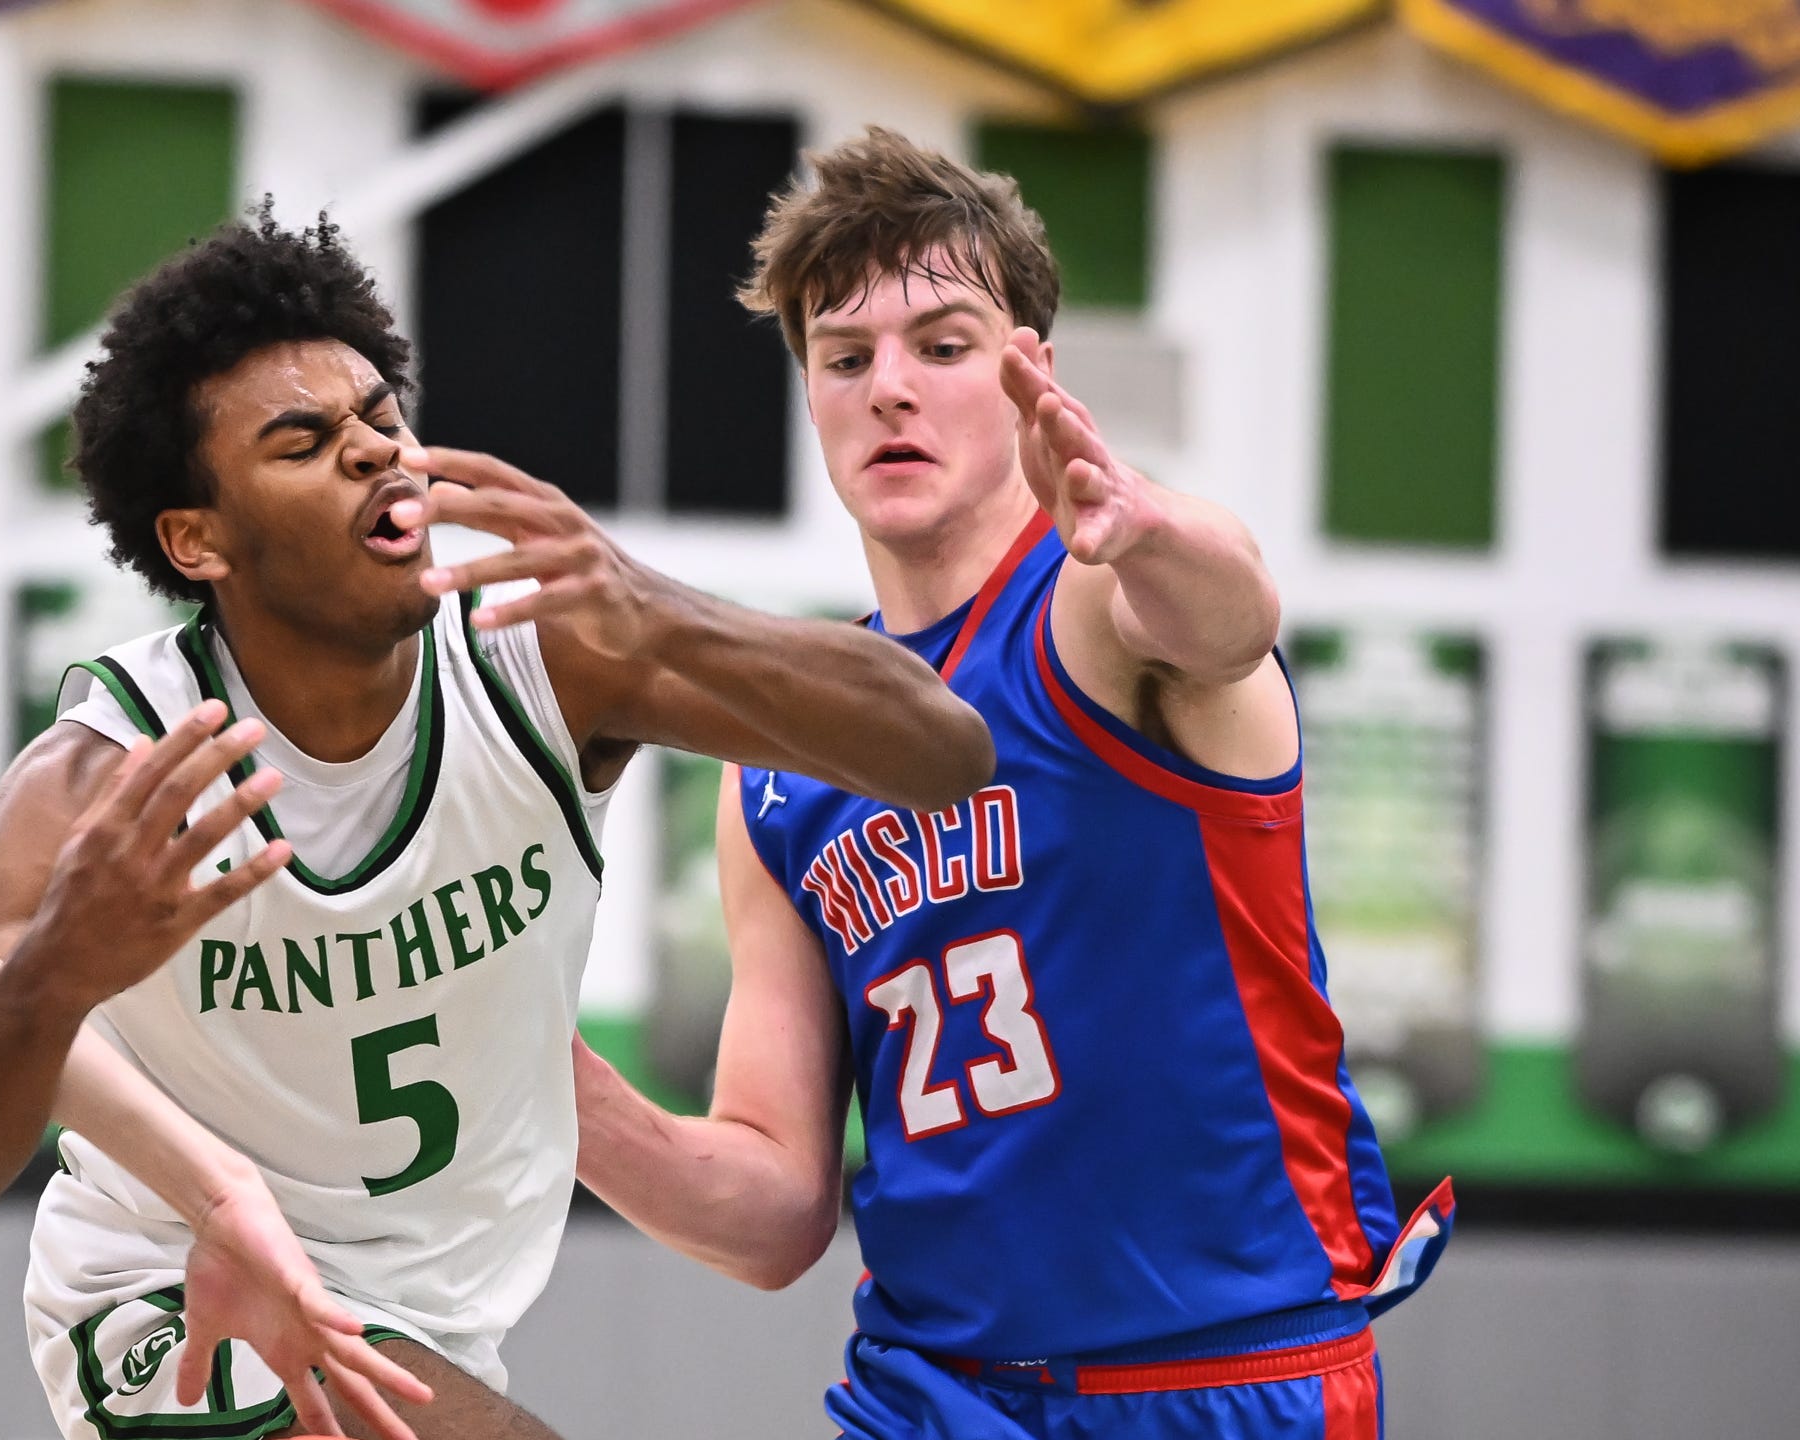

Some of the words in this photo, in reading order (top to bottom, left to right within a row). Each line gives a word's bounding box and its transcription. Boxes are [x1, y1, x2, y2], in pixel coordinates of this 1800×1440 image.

[200, 843, 552, 1014] PANTHERS
[801, 785, 1024, 956] WISCO
[351, 1013, 460, 1198] 5
[864, 928, 1062, 1142] 23
